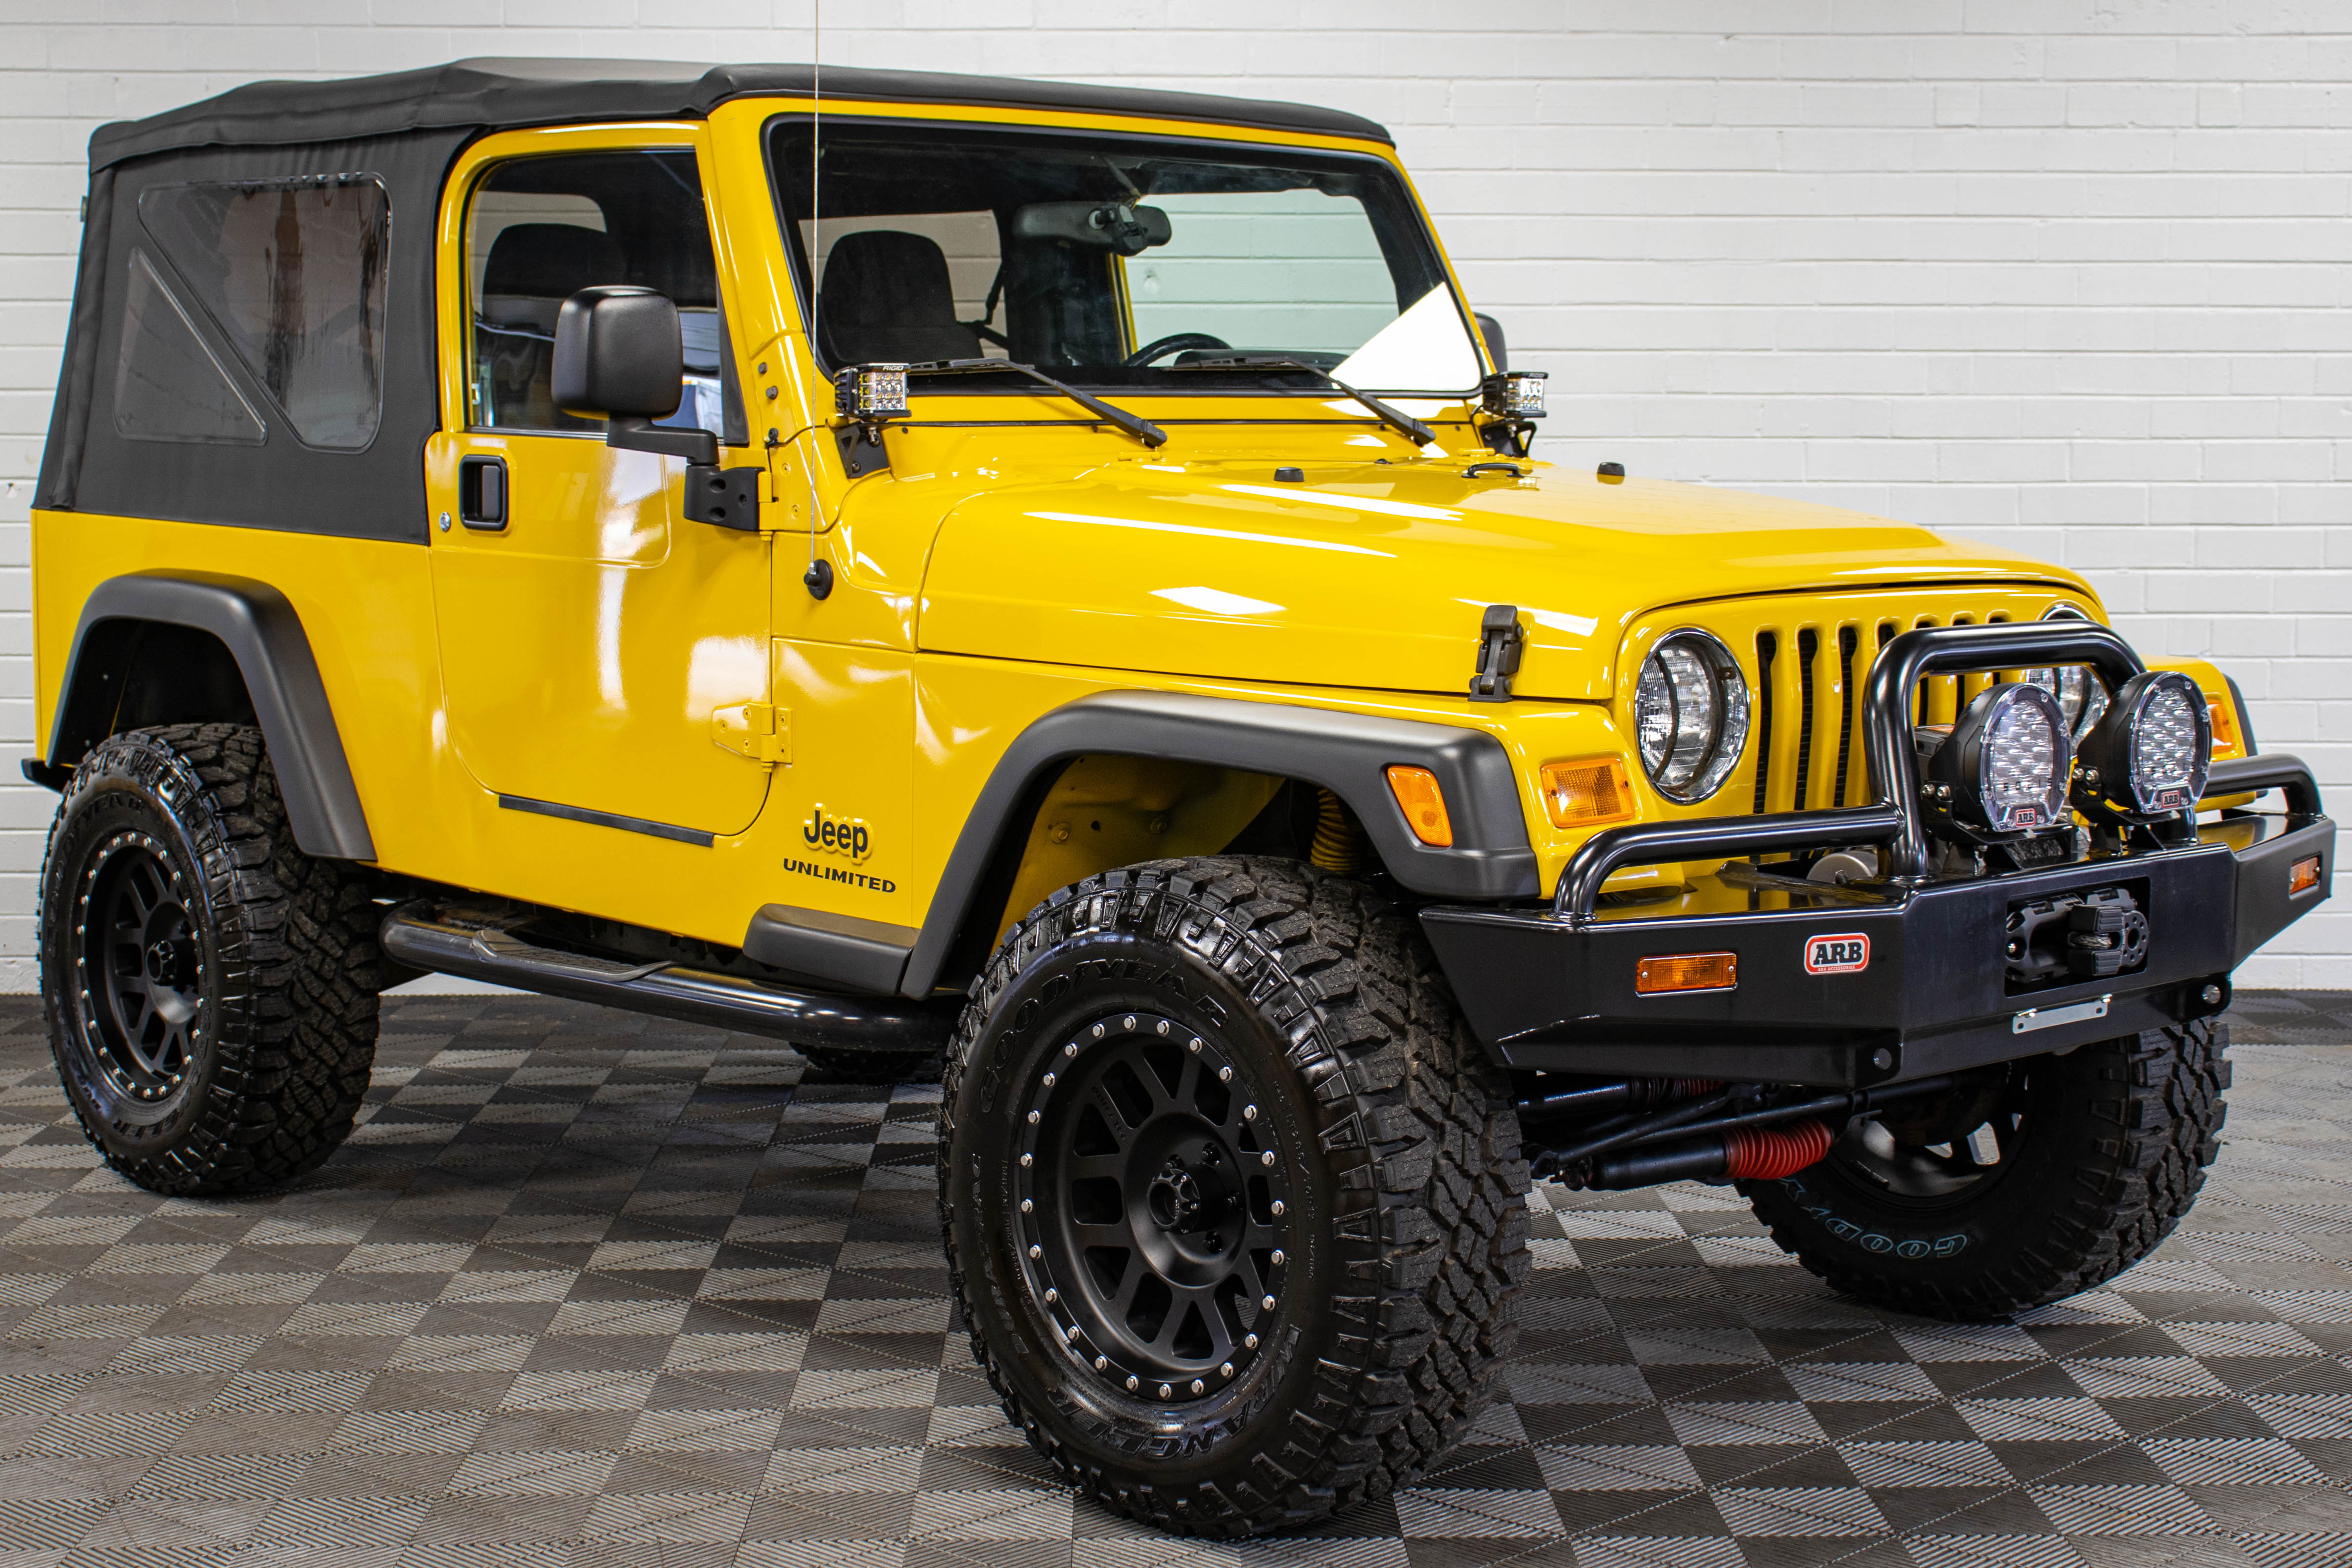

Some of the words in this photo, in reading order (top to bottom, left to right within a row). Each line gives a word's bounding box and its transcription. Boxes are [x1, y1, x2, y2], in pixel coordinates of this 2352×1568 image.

[803, 809, 869, 859] Jeep
[2017, 812, 2034, 823] ARB
[783, 858, 896, 893] UNLIMITED
[1813, 942, 1863, 965] ARB
[979, 959, 1230, 1114] GOODYEAR
